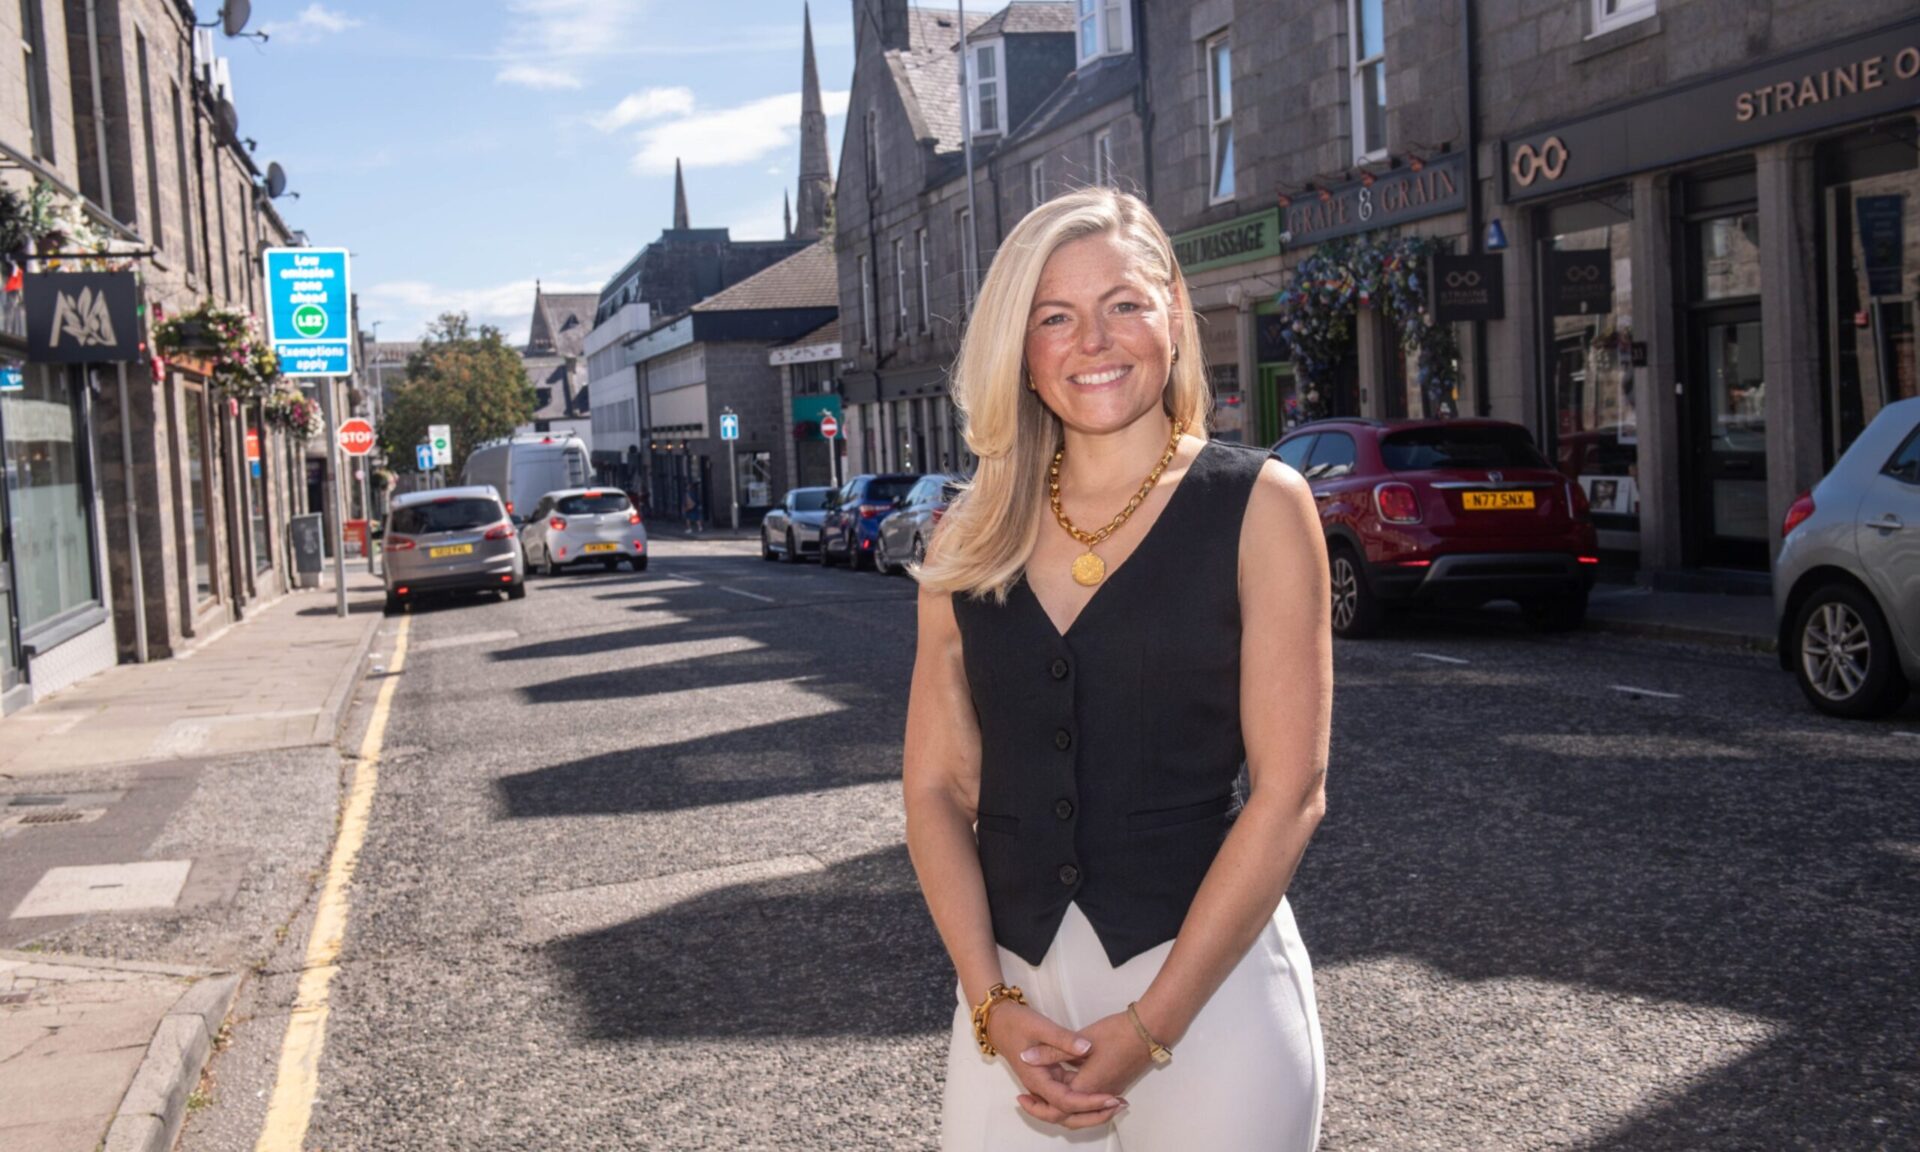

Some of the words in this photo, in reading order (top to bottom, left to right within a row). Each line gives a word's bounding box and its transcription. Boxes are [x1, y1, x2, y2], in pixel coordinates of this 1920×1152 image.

[1736, 57, 1883, 121] STRAINE
[1289, 195, 1349, 234] GRAPE
[1358, 187, 1373, 221] &
[1381, 170, 1455, 213] GRAIN
[1200, 222, 1265, 263] MASSAGE
[294, 254, 320, 267] Low
[280, 267, 334, 279] emission
[293, 281, 323, 291] zone
[290, 291, 328, 304] ahead
[298, 314, 322, 327] LEZ
[278, 345, 344, 358] Exemptions
[296, 360, 328, 371] apply
[340, 431, 374, 444] STOP
[1473, 493, 1497, 507] N77
[1500, 493, 1525, 506] SNX
